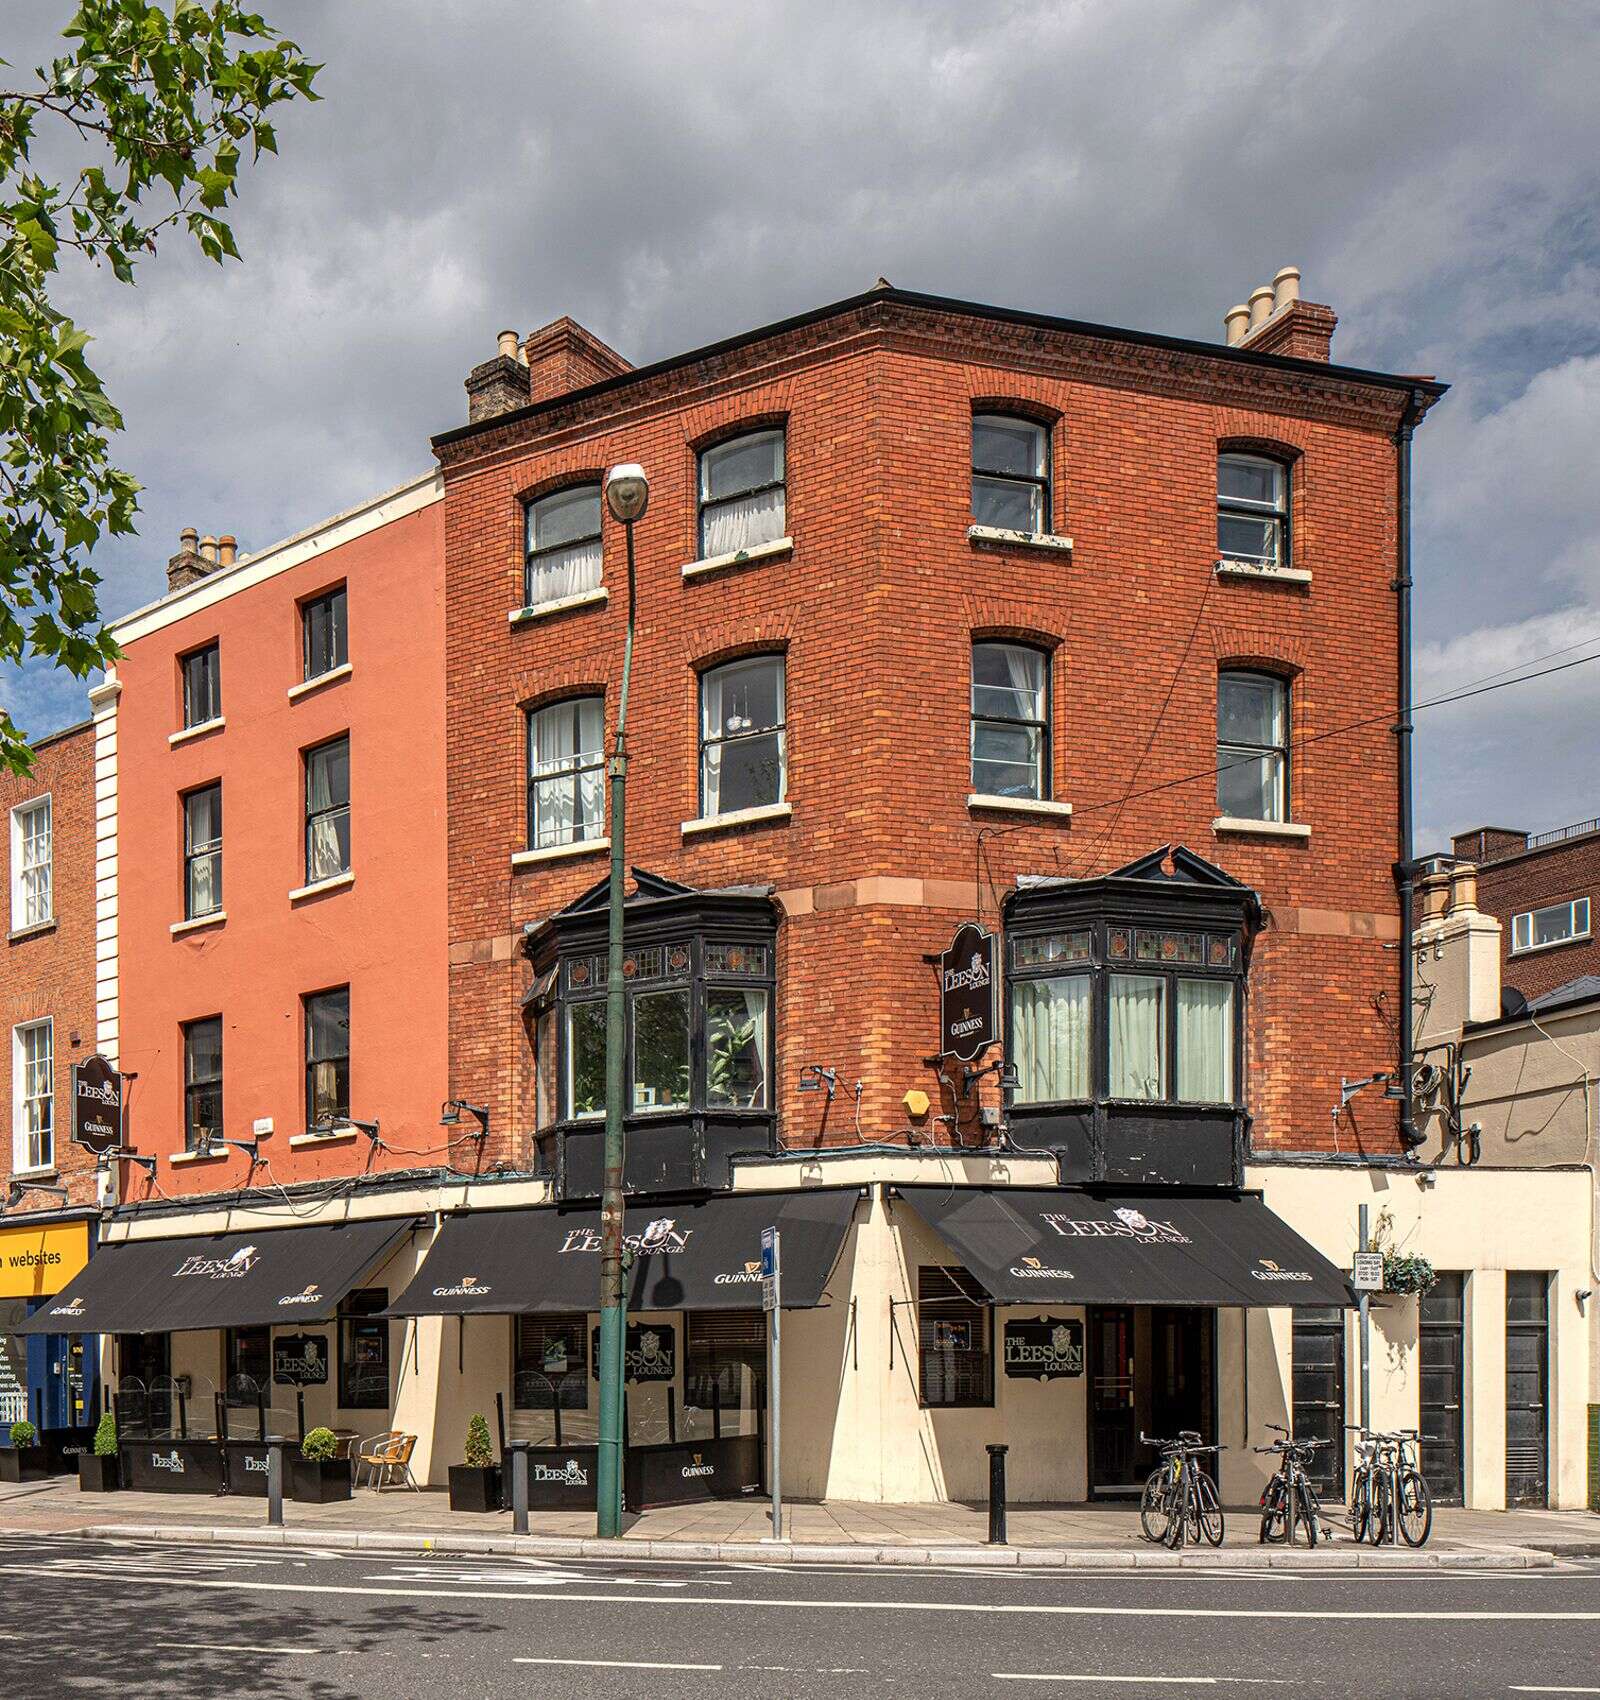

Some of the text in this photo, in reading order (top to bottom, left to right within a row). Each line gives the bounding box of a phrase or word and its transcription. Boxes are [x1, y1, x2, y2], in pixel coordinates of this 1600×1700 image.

[944, 962, 991, 992] LEESON
[951, 1017, 983, 1036] GUINNESS
[77, 1085, 120, 1102] LEESON
[84, 1121, 114, 1134] GUINNESS
[1039, 1213, 1070, 1222] THE
[567, 1228, 597, 1239] THE
[1046, 1220, 1183, 1238] LEESON
[557, 1229, 694, 1253] LESON
[1136, 1236, 1193, 1244] LOUNGE
[9, 1249, 62, 1268] websites
[171, 1256, 261, 1277] LEESON
[714, 1273, 765, 1284] GUINNE
[1009, 1267, 1075, 1280] GUINNESS
[1251, 1270, 1313, 1281] GUINNESS
[432, 1286, 492, 1296] GUINNESS
[278, 1294, 324, 1305] GUINNESS
[1006, 1337, 1026, 1346] THE
[1006, 1345, 1083, 1363] LEESON
[275, 1358, 327, 1373] LEESON
[633, 1366, 673, 1375] LOUNGE
[1044, 1362, 1083, 1371] LOUNGE
[62, 1446, 88, 1455] GUINNESS
[152, 1457, 184, 1470] LEESON
[245, 1459, 270, 1472] LEES
[535, 1468, 588, 1482] LEESON
[682, 1465, 715, 1478] GUINNESS
